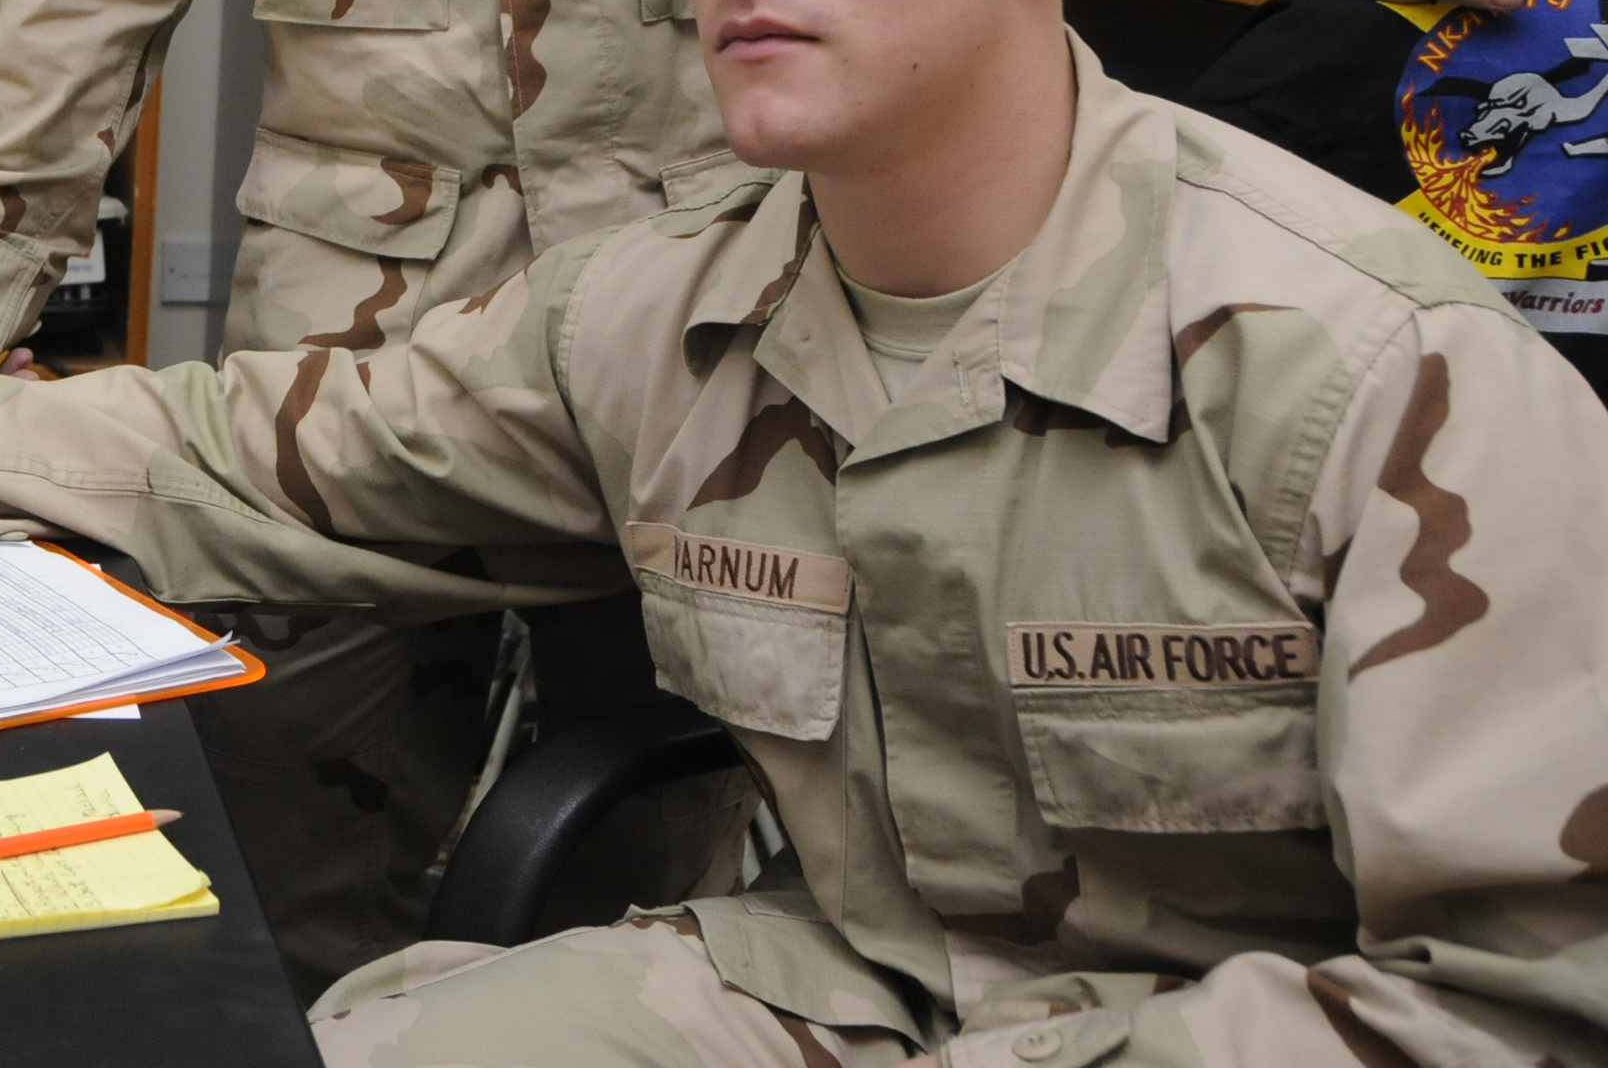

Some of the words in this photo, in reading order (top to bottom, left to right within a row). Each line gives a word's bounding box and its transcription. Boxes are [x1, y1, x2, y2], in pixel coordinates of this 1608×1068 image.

[1514, 251, 1562, 268] THE
[1022, 633, 1085, 680] U.S.
[1091, 633, 1155, 680] AIR
[1163, 635, 1305, 682] FORCE
